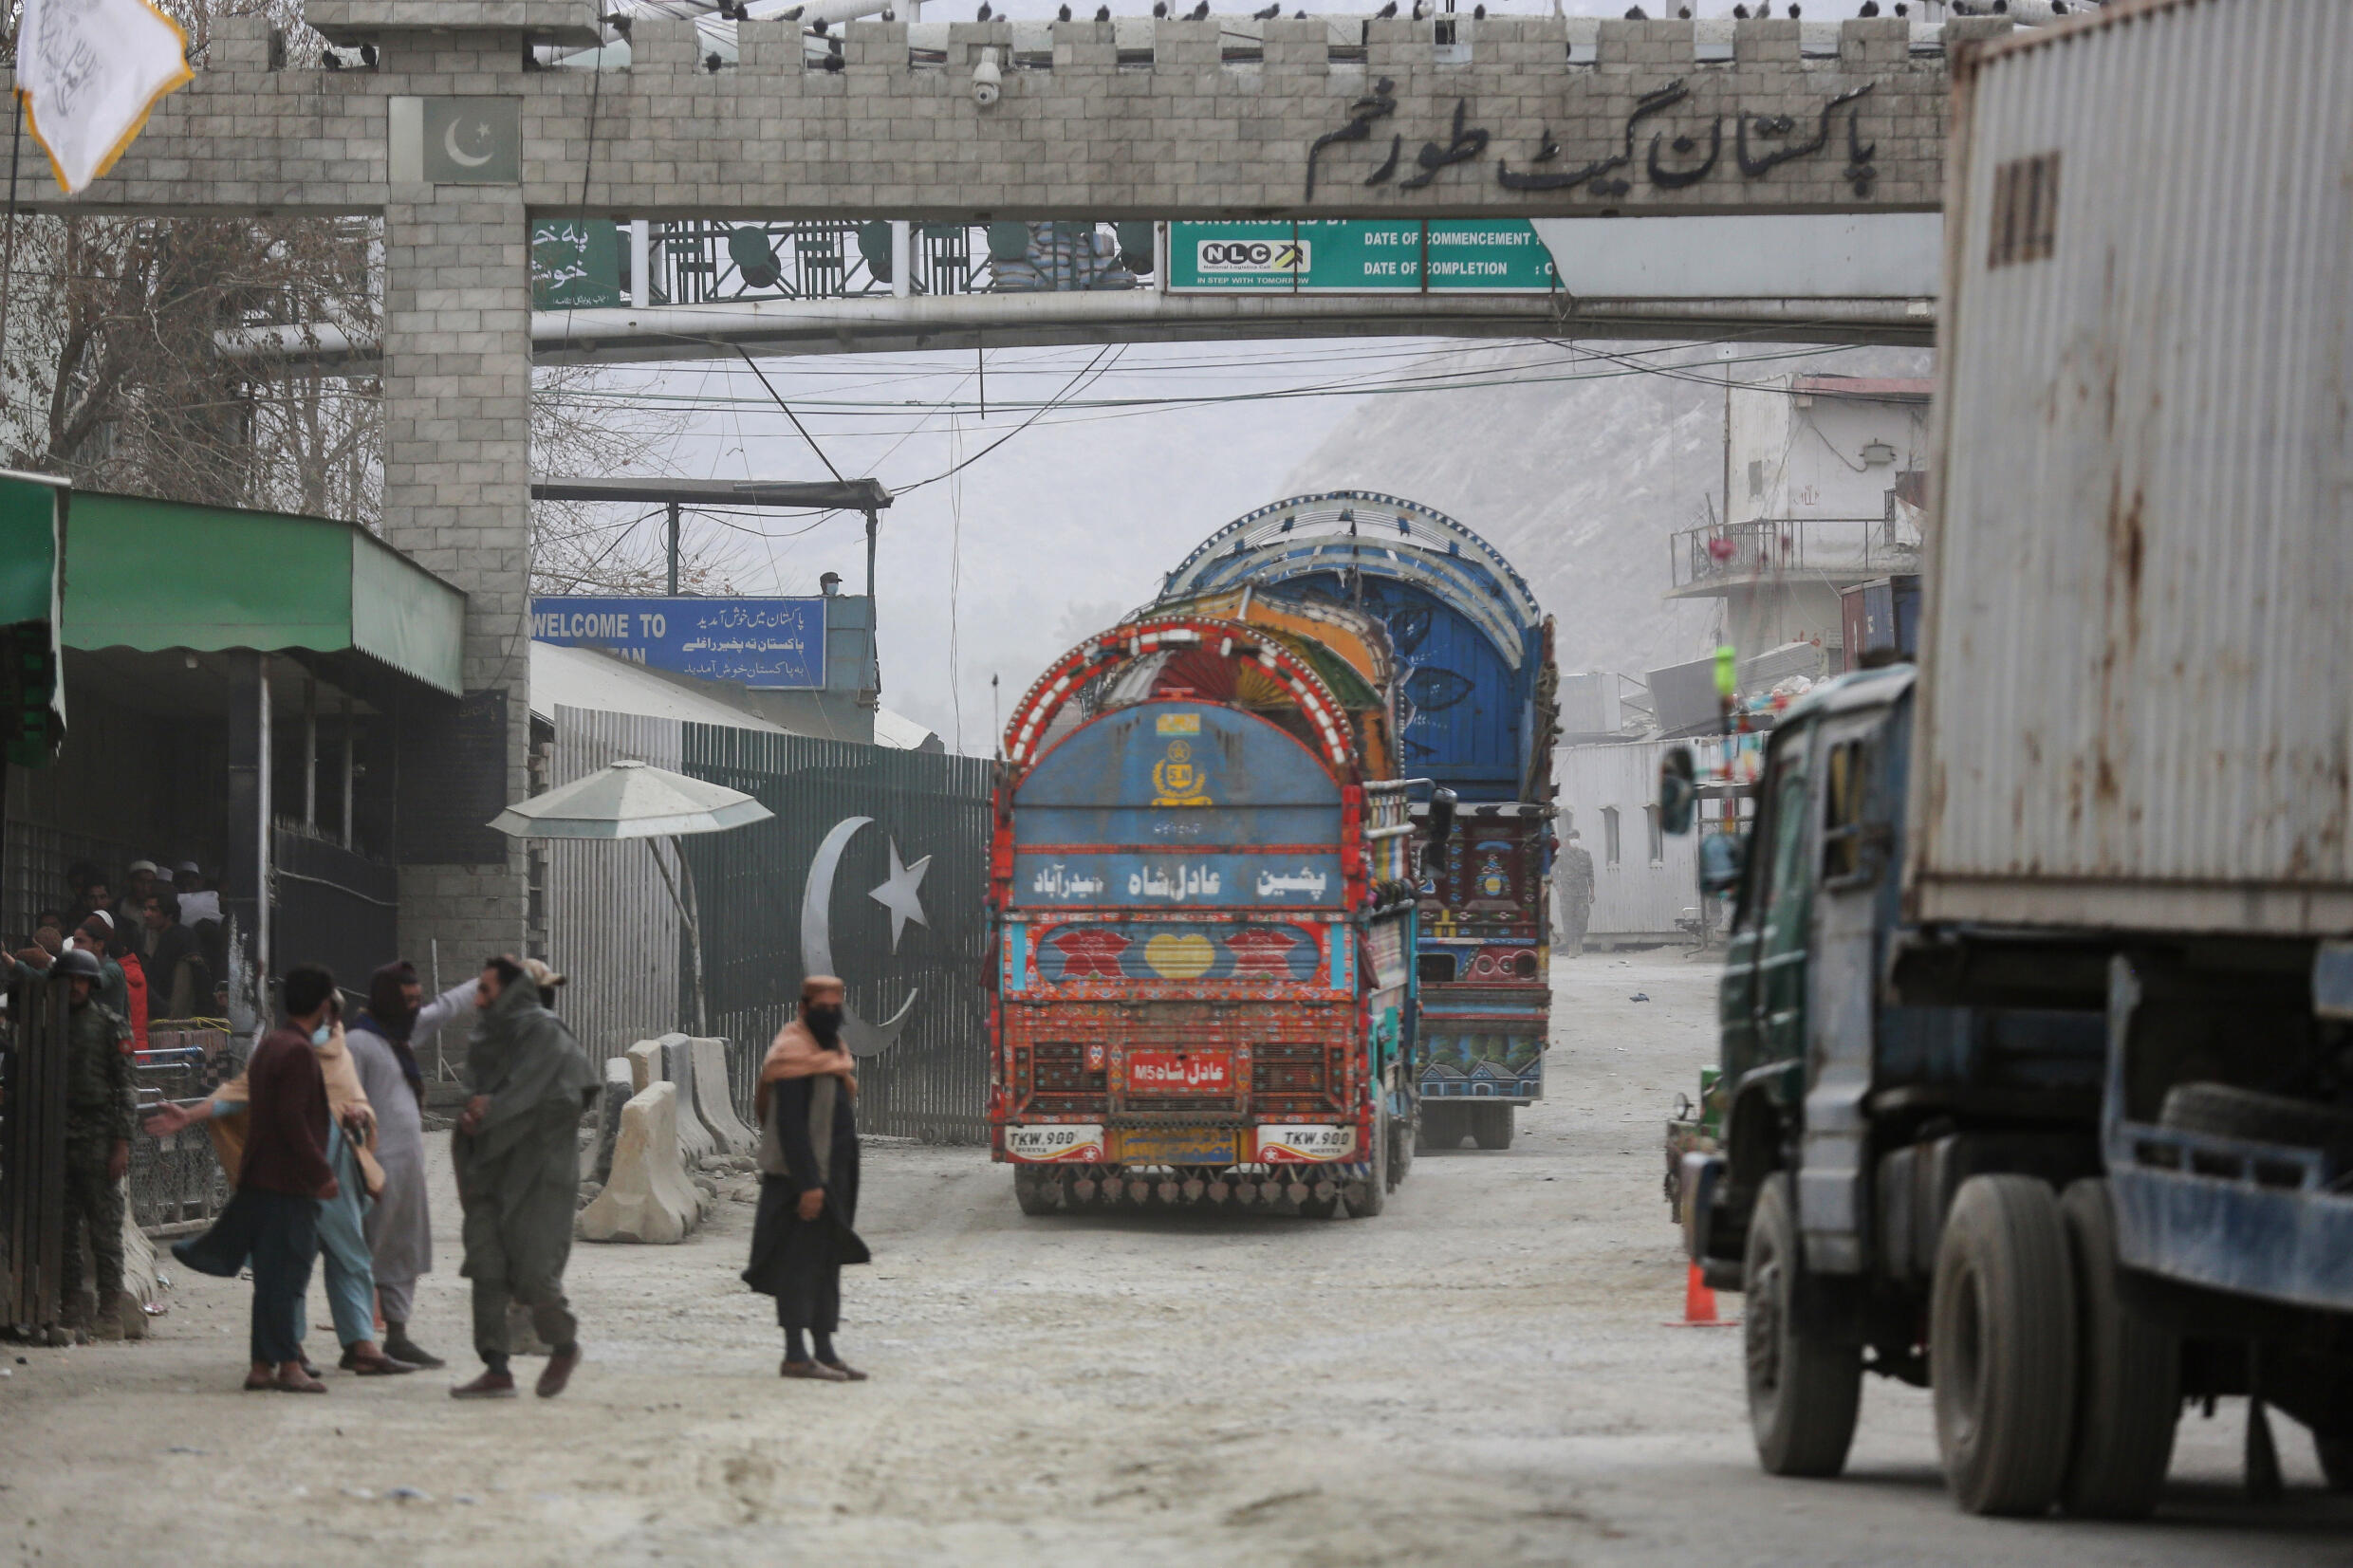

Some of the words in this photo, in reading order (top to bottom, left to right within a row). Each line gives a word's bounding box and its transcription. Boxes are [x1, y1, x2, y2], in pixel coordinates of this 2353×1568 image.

[1305, 76, 1490, 203] طورخم
[1497, 76, 1691, 196] گیٹ
[1647, 80, 1877, 197] پاکستان
[1363, 231, 1399, 246] DATE
[1401, 231, 1419, 246] OF
[1206, 245, 1269, 262] NLC
[1363, 262, 1397, 275] DATE
[1400, 262, 1417, 275] OF
[530, 613, 630, 638] WELCOME
[639, 613, 666, 638] TO
[724, 606, 748, 628] خوش
[747, 610, 766, 628] میں
[767, 606, 805, 631] پاکستان
[758, 637, 805, 655] پاکستان
[716, 663, 748, 678] خوش
[1256, 866, 1326, 901] پشین
